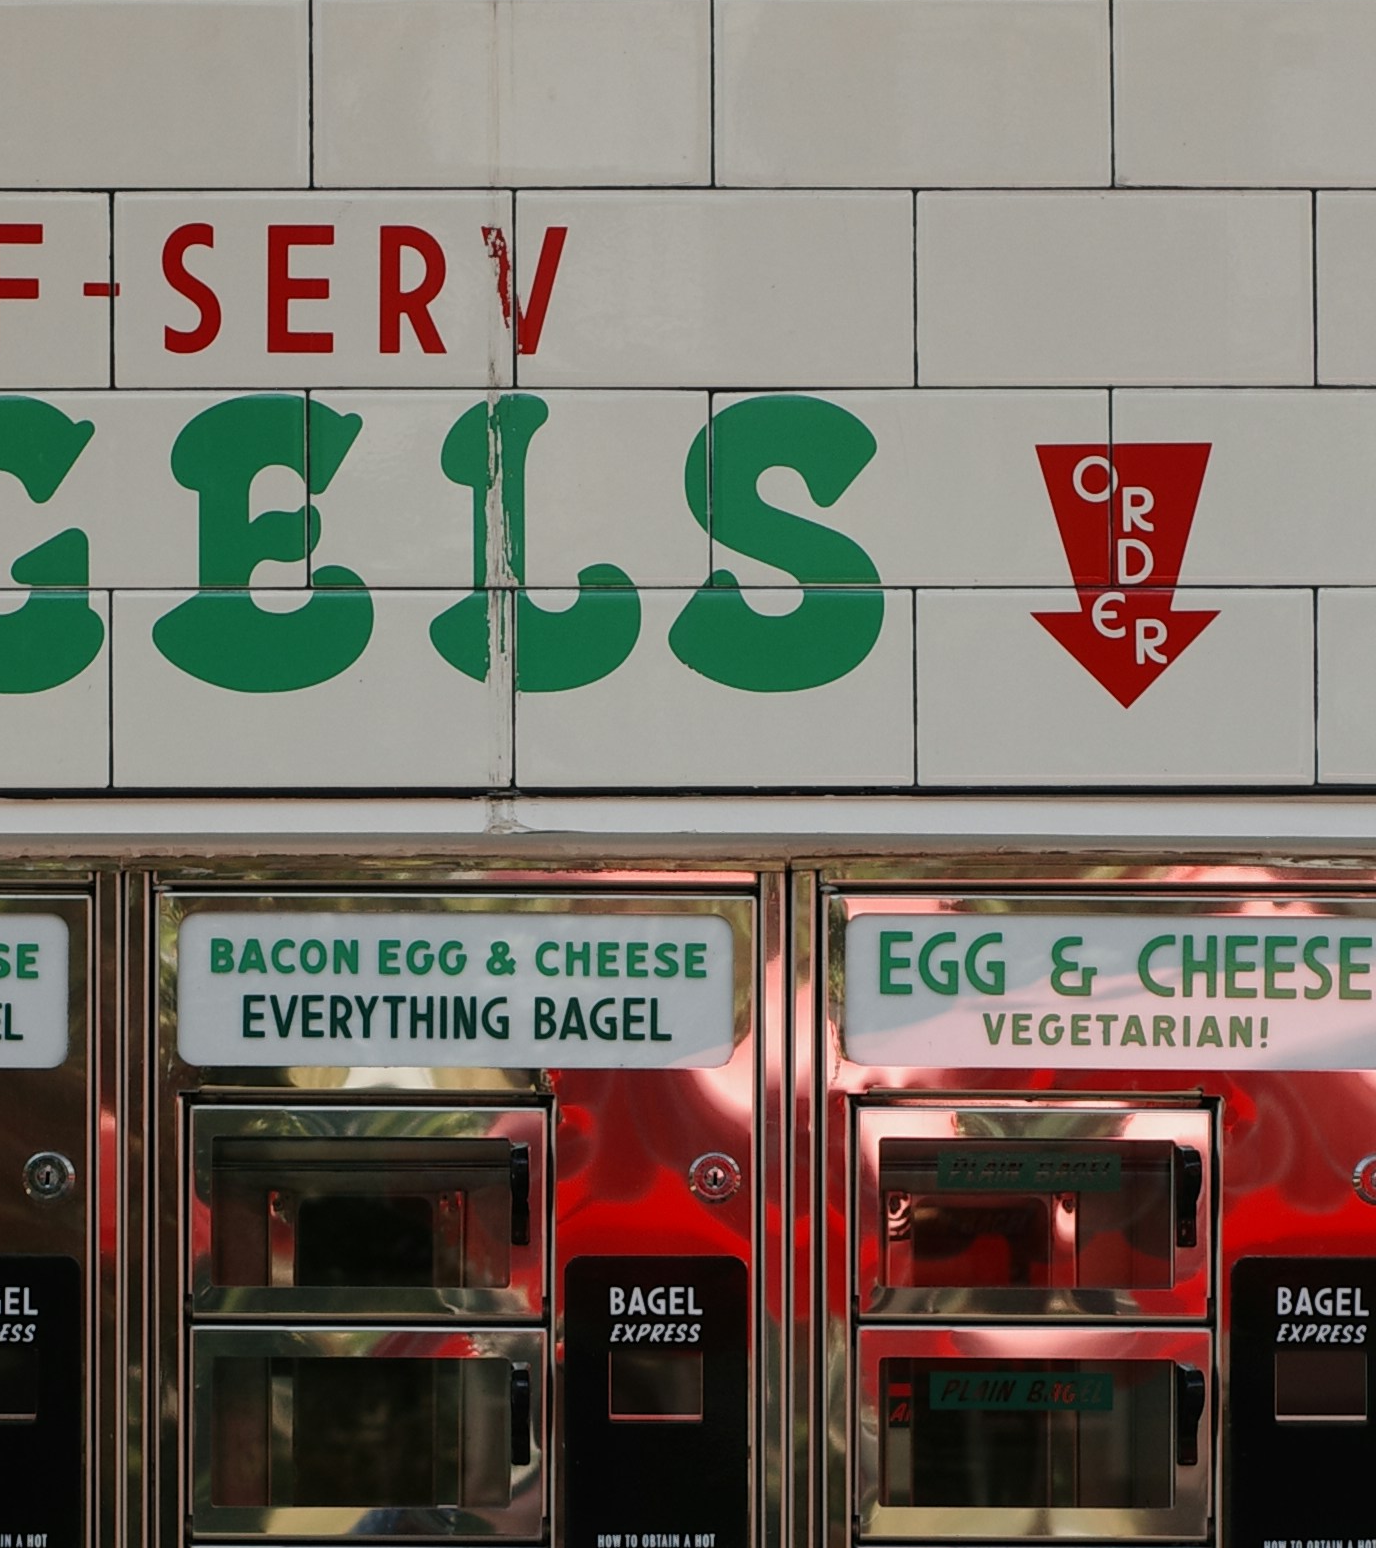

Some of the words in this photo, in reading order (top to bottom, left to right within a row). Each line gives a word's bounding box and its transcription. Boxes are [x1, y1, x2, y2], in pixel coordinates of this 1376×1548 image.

[1072, 455, 1168, 665] ORDER
[211, 938, 358, 974] BACON
[378, 940, 467, 976] EGG
[486, 941, 516, 975] &
[536, 942, 706, 978] CHEESE
[879, 931, 1005, 996] EGG
[1051, 936, 1097, 996] &
[1138, 935, 1372, 999] CHEESE
[243, 995, 509, 1039] EVERYTHING
[535, 997, 672, 1041] BAGEL
[983, 1013, 1268, 1048] VEGETARIAN!
[609, 1286, 703, 1316] BAGEL
[1277, 1286, 1370, 1317] BAGEL
[609, 1323, 701, 1343] EXPRESS
[1276, 1323, 1367, 1344] EXPRESS
[15, 1534, 23, 1548] A
[26, 1533, 48, 1548] HOT
[597, 1534, 622, 1548] HOW
[625, 1534, 638, 1548] TO
[641, 1533, 680, 1548] OBTAIN
[683, 1534, 691, 1548] A
[694, 1533, 716, 1548] HOT
